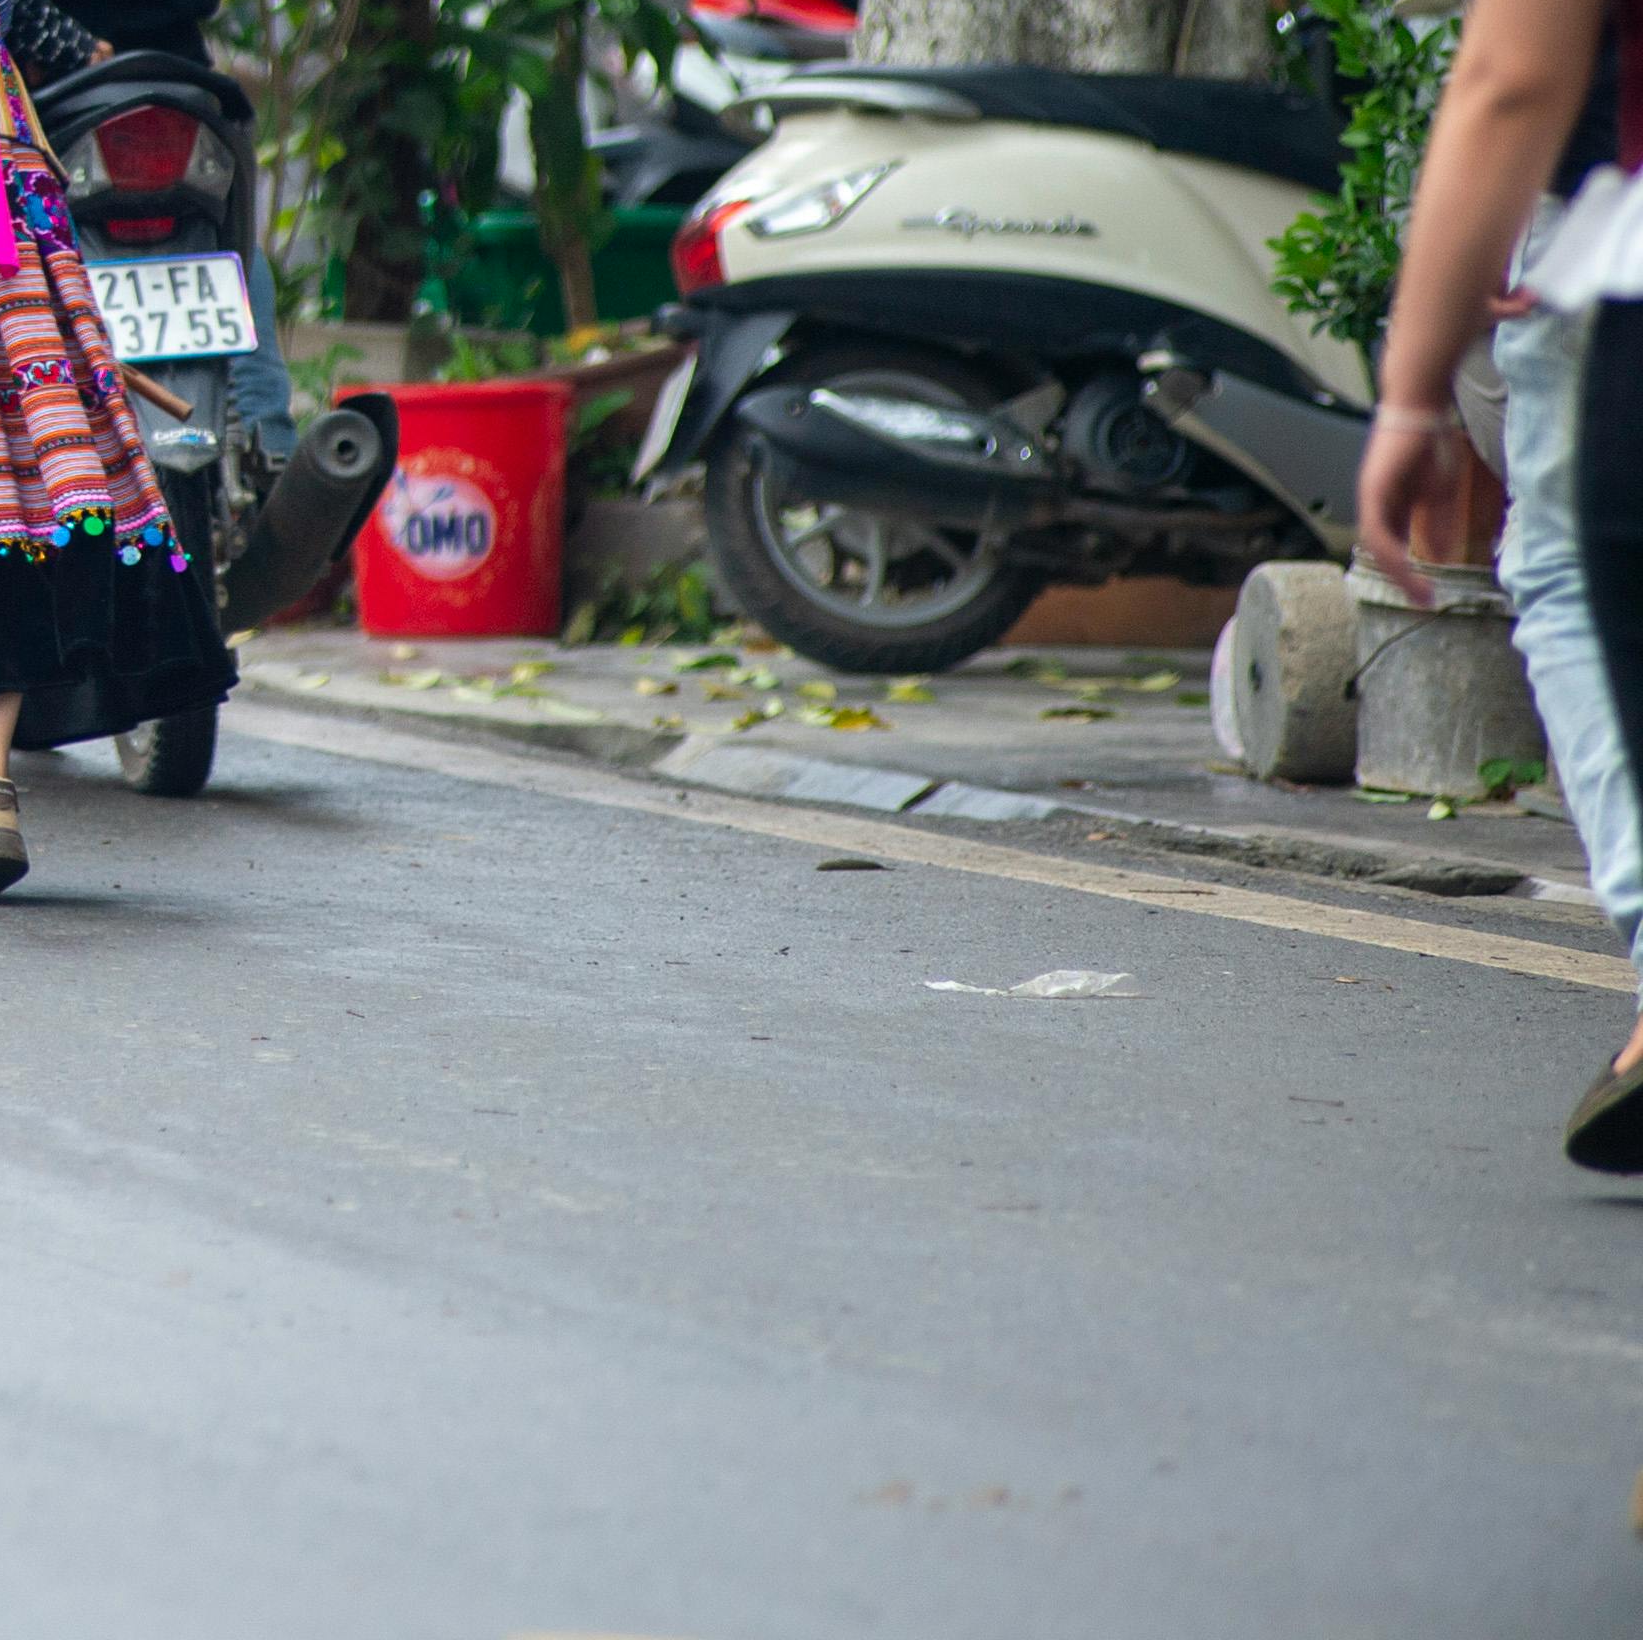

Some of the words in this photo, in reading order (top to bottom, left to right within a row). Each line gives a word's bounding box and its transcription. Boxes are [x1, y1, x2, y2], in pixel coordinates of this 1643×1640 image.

[98, 264, 218, 311] 21-FA
[118, 307, 243, 354] 37.55
[406, 511, 491, 556] OMO
